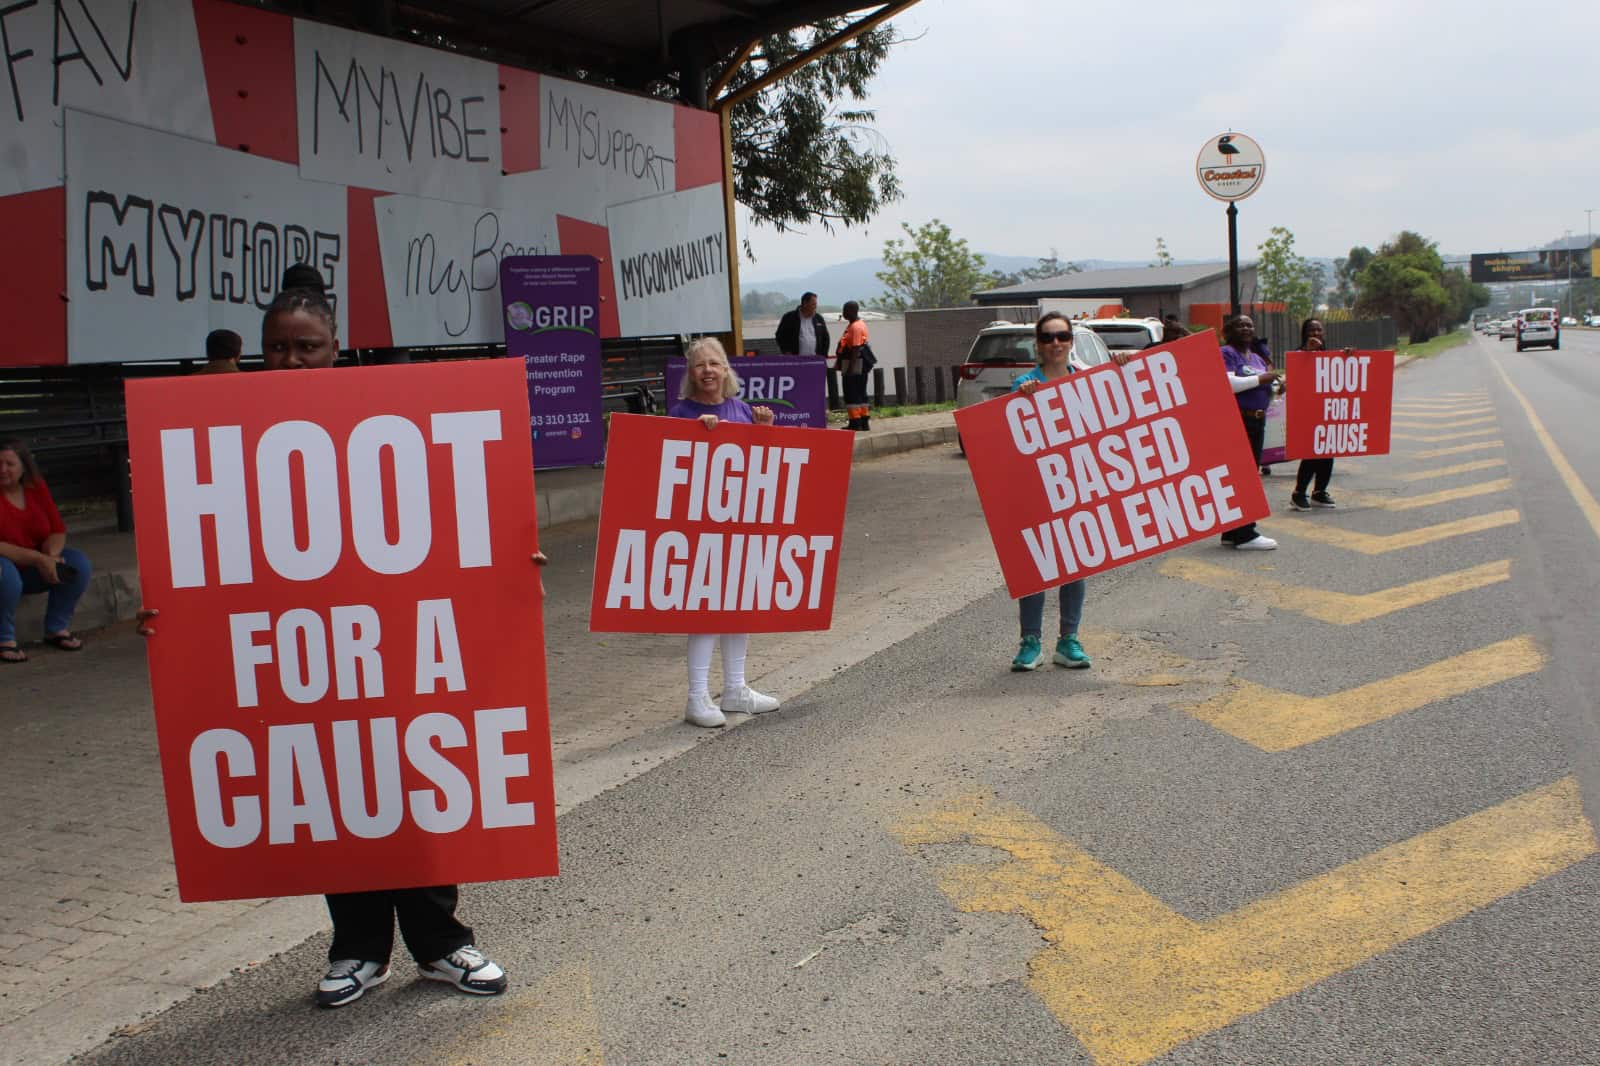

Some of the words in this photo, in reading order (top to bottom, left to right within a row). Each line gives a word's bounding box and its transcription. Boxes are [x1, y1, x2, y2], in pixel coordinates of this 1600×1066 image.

[547, 90, 675, 191] MYSUPPORT
[620, 231, 724, 300] MYCOMMUNITY
[535, 305, 594, 327] GRIP
[525, 354, 558, 364] Greater
[560, 353, 585, 364] Rape
[526, 369, 583, 380] Intervention
[534, 385, 575, 396] Program
[1315, 356, 1370, 393] HOOT
[545, 414, 565, 425] 310
[567, 413, 590, 424] 1321
[779, 411, 810, 421] Program
[1005, 351, 1188, 455] GENDER
[1324, 398, 1349, 421] FOR
[1352, 397, 1361, 420] A
[1036, 416, 1190, 513] BASED
[1313, 423, 1368, 455] CAUSE
[160, 410, 502, 589] HOOT
[655, 439, 810, 525] FIGHT
[1021, 464, 1243, 582] VIOLENCE
[605, 528, 834, 611] AGAINST
[229, 604, 385, 708] FOR
[415, 598, 467, 695] A
[189, 706, 536, 849] CAUSE
